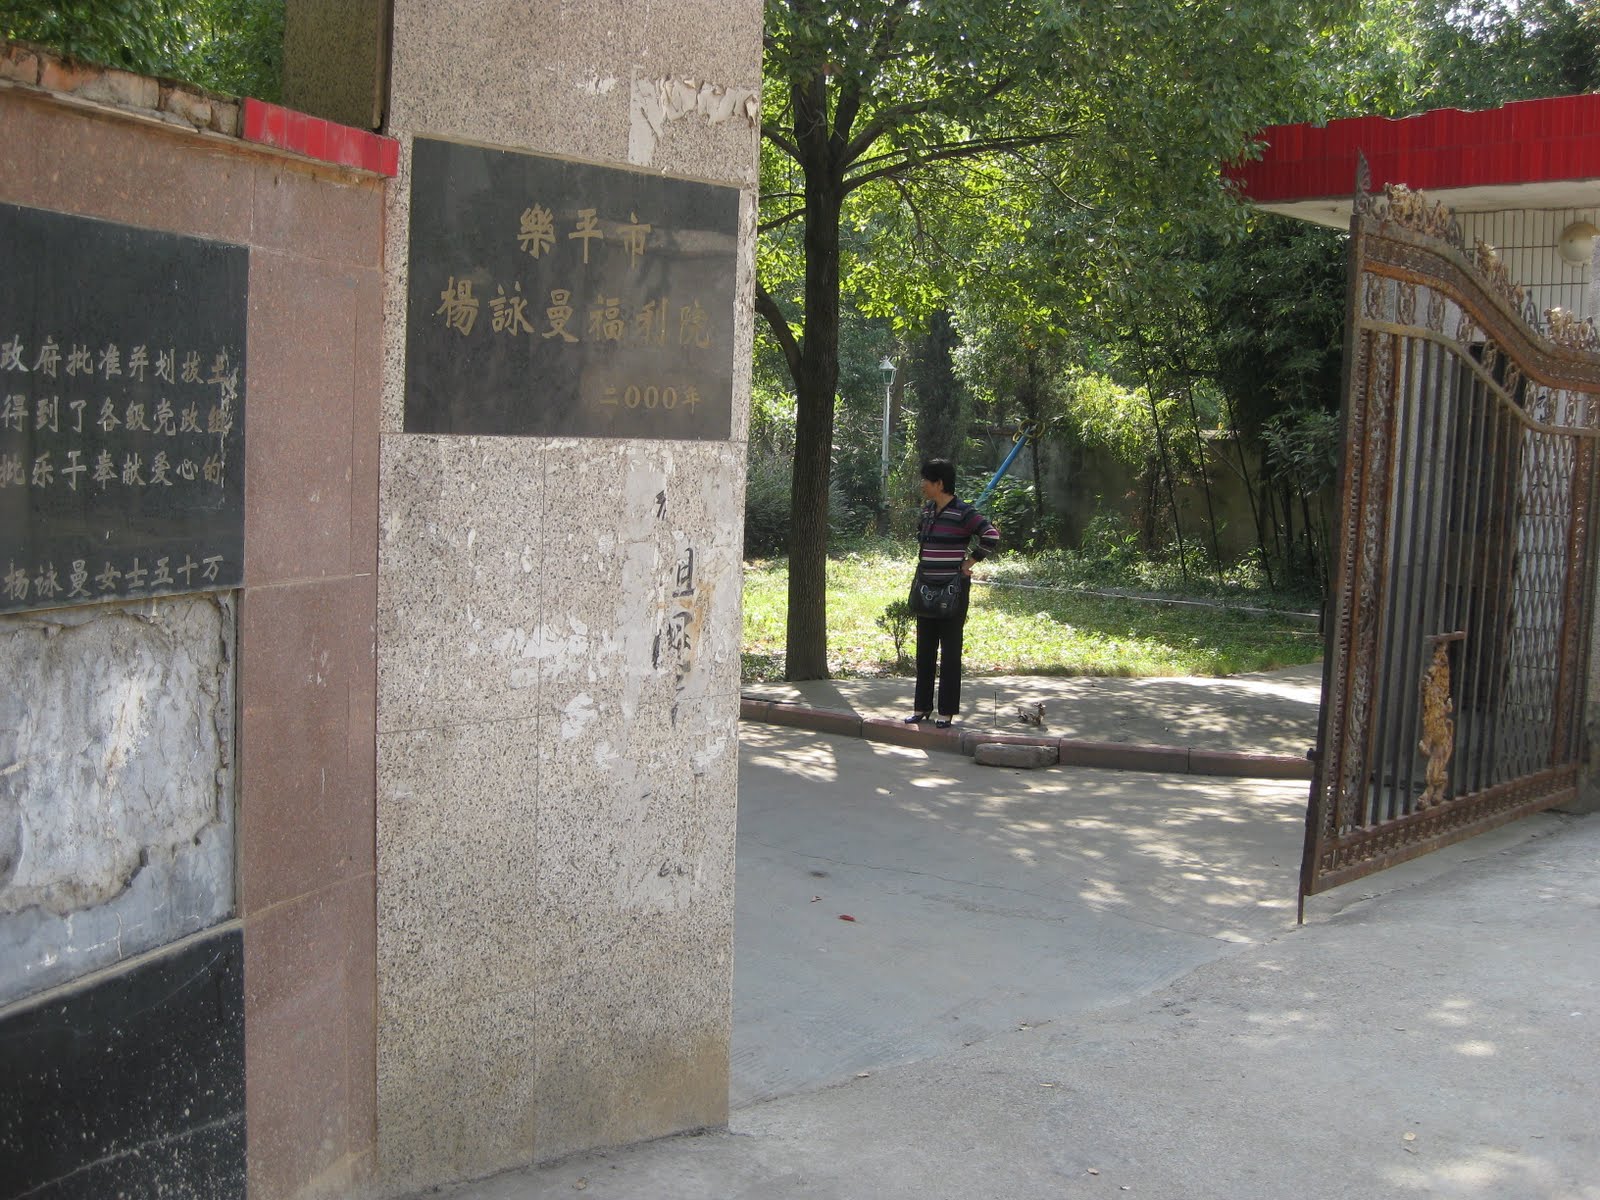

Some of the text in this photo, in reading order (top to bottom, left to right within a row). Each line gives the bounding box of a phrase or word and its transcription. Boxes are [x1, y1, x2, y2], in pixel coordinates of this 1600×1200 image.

[517, 203, 651, 268] 樂平市
[436, 275, 712, 348] 楊詠曼福利院
